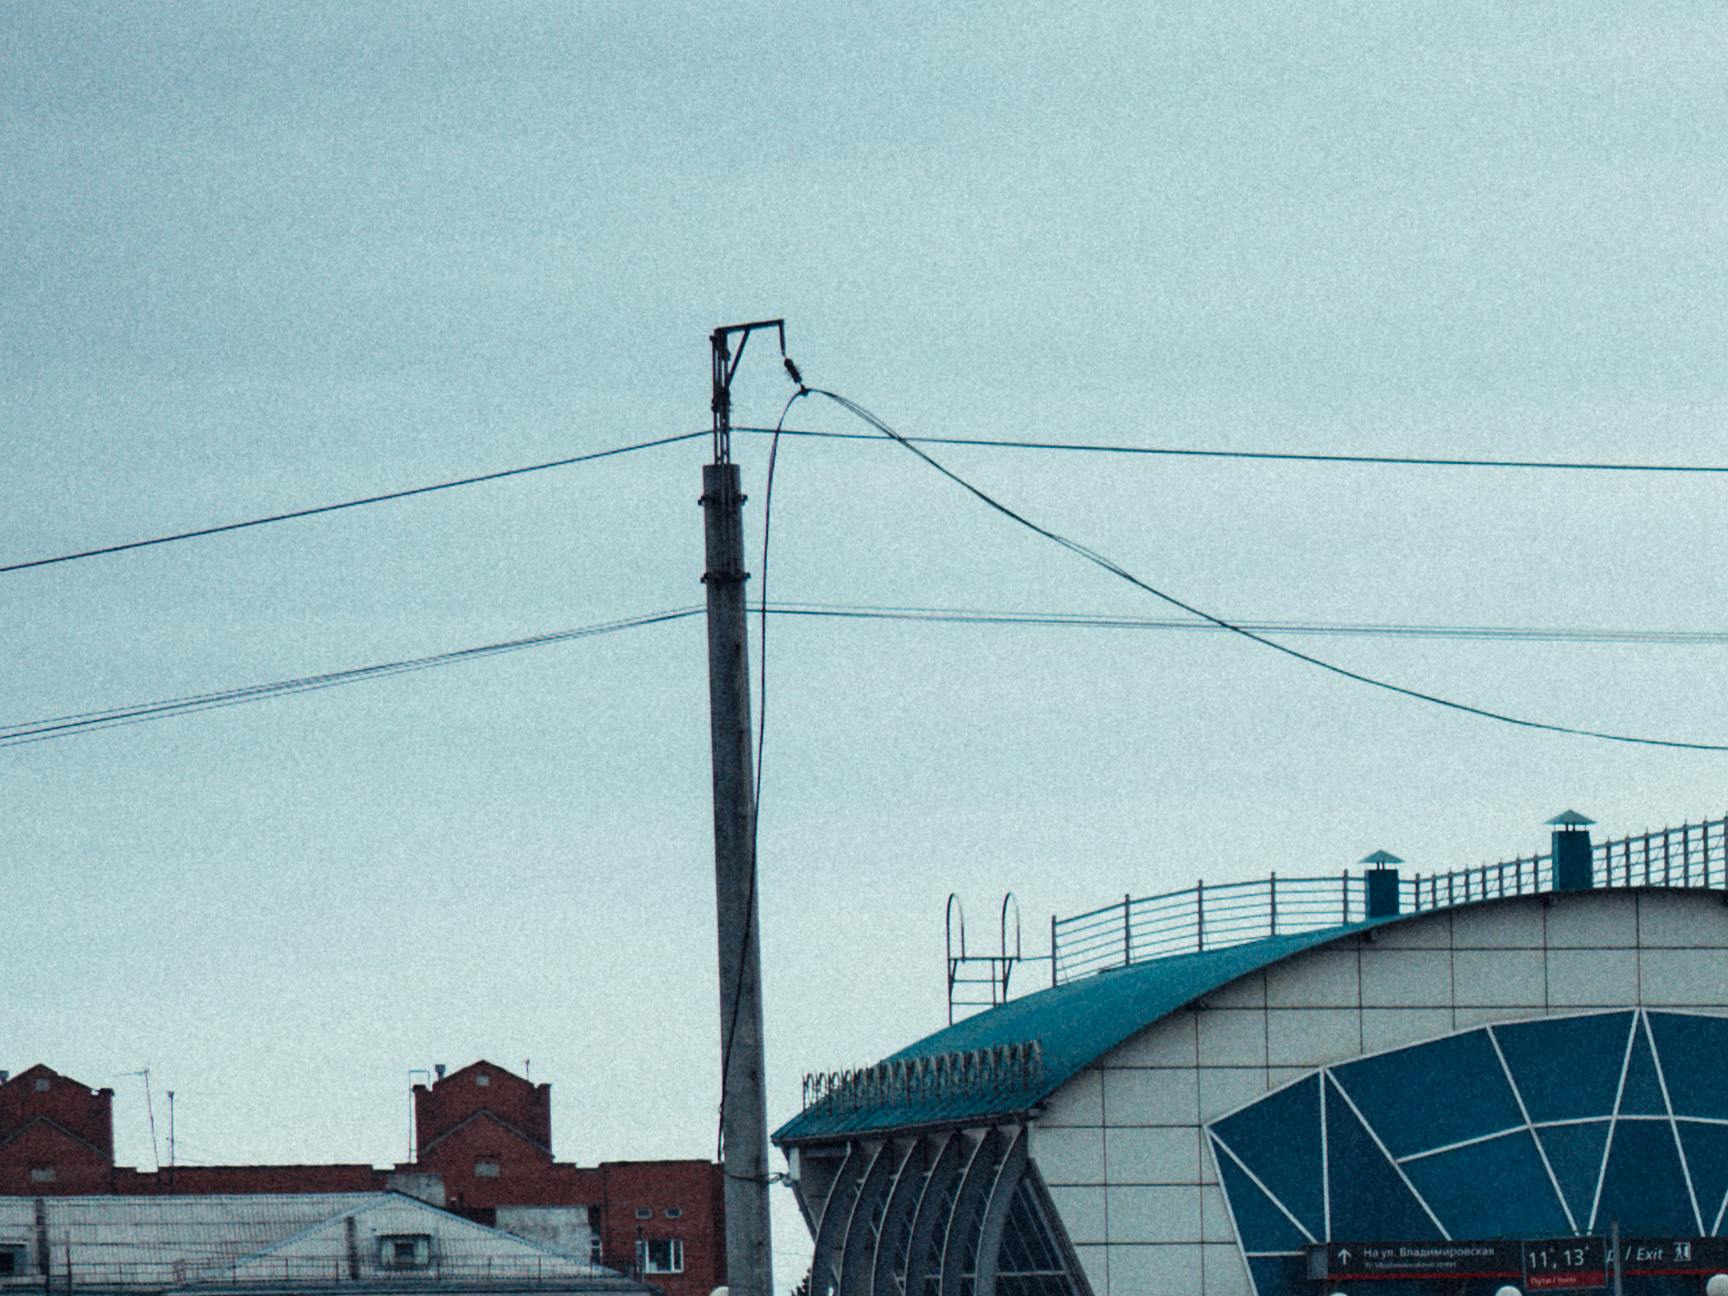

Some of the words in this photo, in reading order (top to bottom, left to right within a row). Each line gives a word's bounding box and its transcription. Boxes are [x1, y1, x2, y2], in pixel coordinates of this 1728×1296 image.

[1363, 1247, 1379, 1258] На
[1399, 1247, 1495, 1260] Владимировская
[1635, 1247, 1664, 1262] Exit
